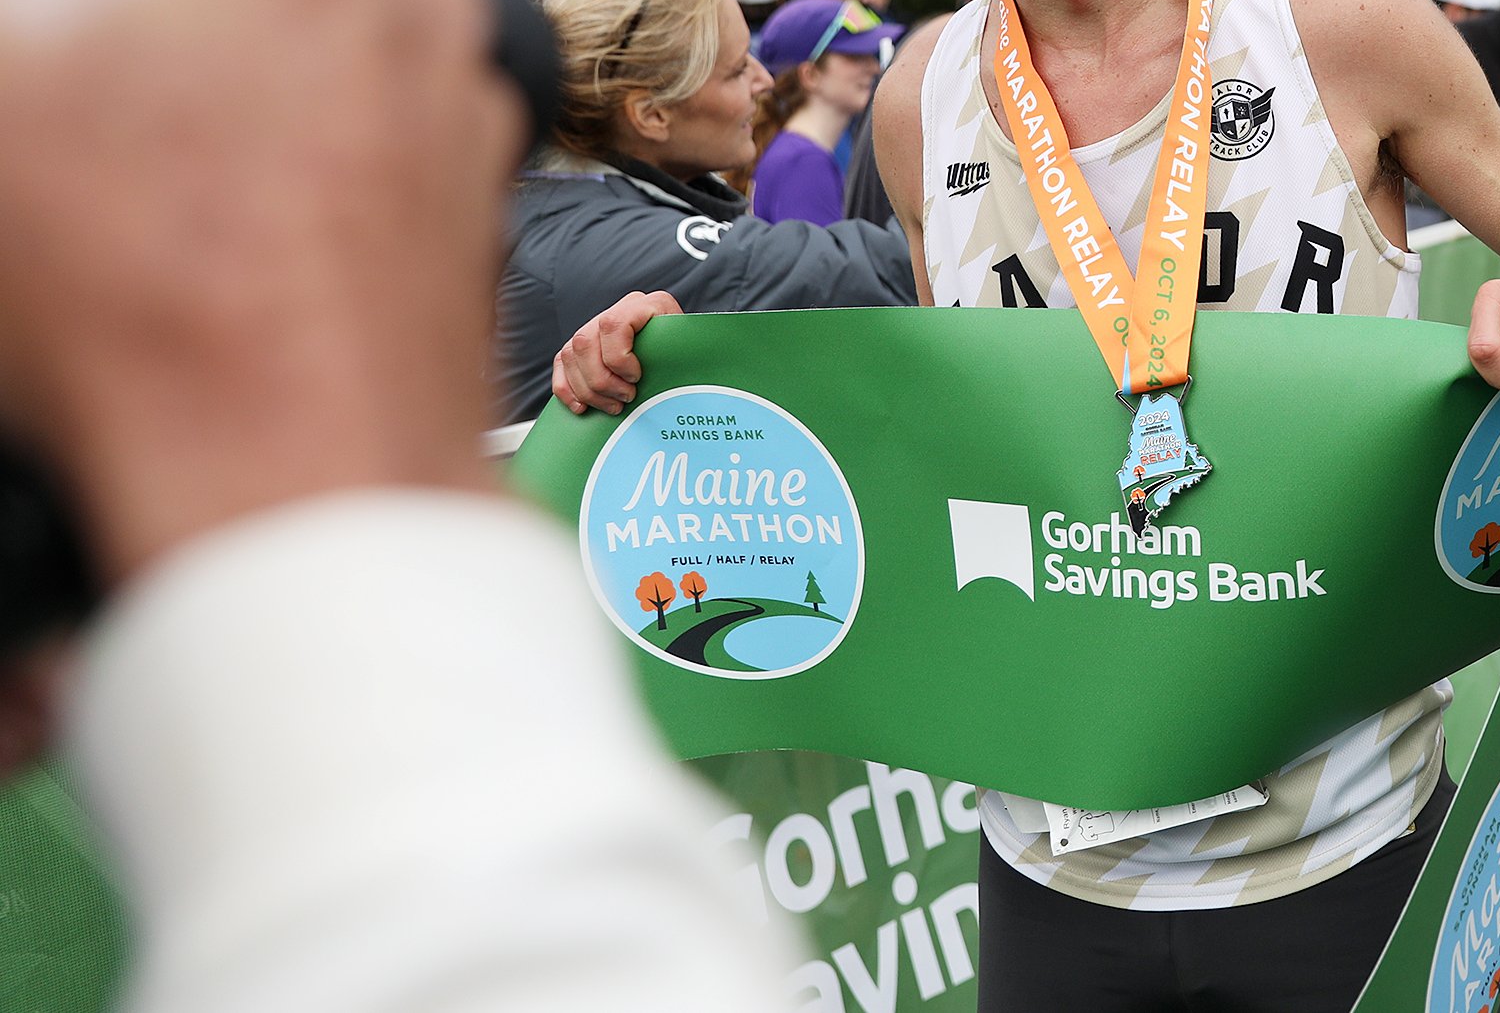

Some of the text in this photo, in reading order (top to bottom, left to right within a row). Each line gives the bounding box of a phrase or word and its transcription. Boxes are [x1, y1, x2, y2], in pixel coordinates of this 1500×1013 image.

[1212, 84, 1253, 100] ALOR
[1246, 130, 1269, 152] CLUB
[1002, 49, 1077, 216] MARATHON
[1063, 216, 1125, 309] RELAY
[1160, 135, 1197, 251] RELAY
[1156, 257, 1177, 303] OCT
[1149, 310, 1170, 327] 6,
[1146, 334, 1167, 387] 2024
[661, 428, 765, 441] SAVINGS BANK
[676, 415, 738, 427] GORHAM
[1139, 411, 1170, 426] 2024
[1140, 448, 1181, 465] RELAY
[1141, 435, 1176, 449] Maine
[622, 450, 807, 512] Maine
[605, 513, 843, 553] MARATHON
[1041, 511, 1201, 556] Gorham
[671, 555, 704, 567] FULL
[716, 554, 747, 566] HALF
[759, 555, 796, 567] RELAY
[1044, 554, 1327, 609] Savings Bank
[1461, 817, 1498, 900] GORHAM
[1454, 851, 1490, 932] SAVINGS
